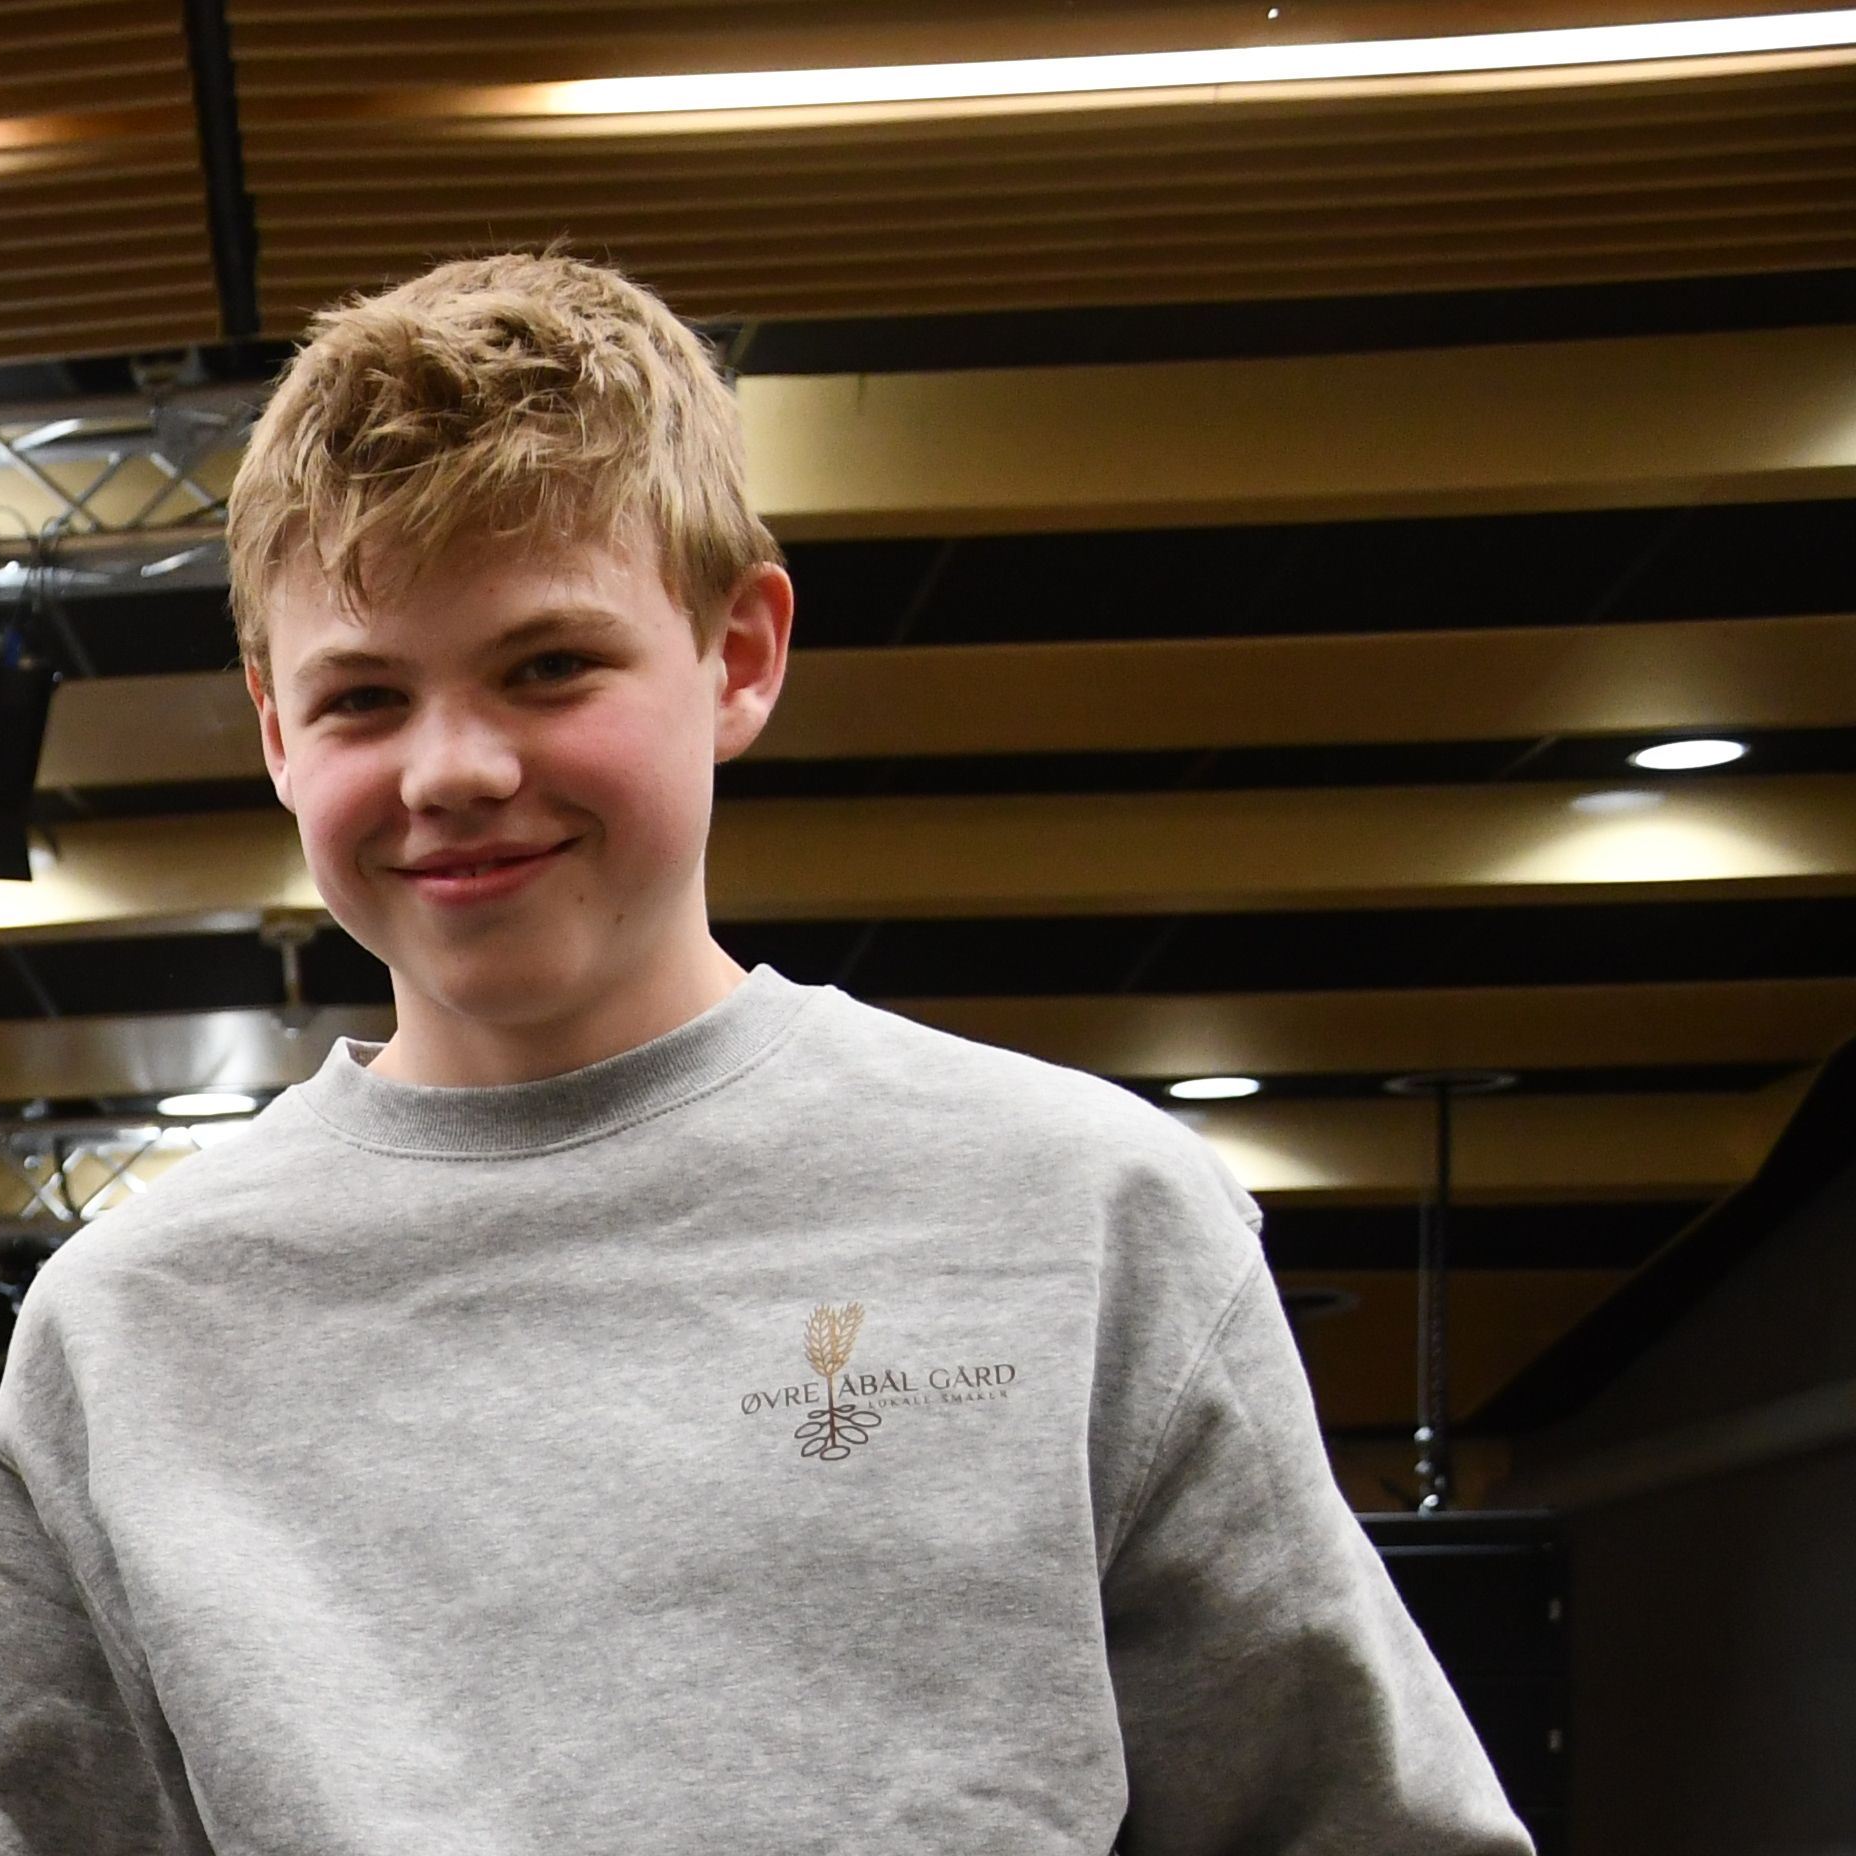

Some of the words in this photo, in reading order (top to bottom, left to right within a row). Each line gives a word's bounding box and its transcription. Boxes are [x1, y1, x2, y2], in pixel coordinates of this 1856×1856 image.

[741, 1382, 820, 1415] ØVRE
[838, 1369, 918, 1398] ÅBÅL
[929, 1363, 1016, 1390] GÅRD
